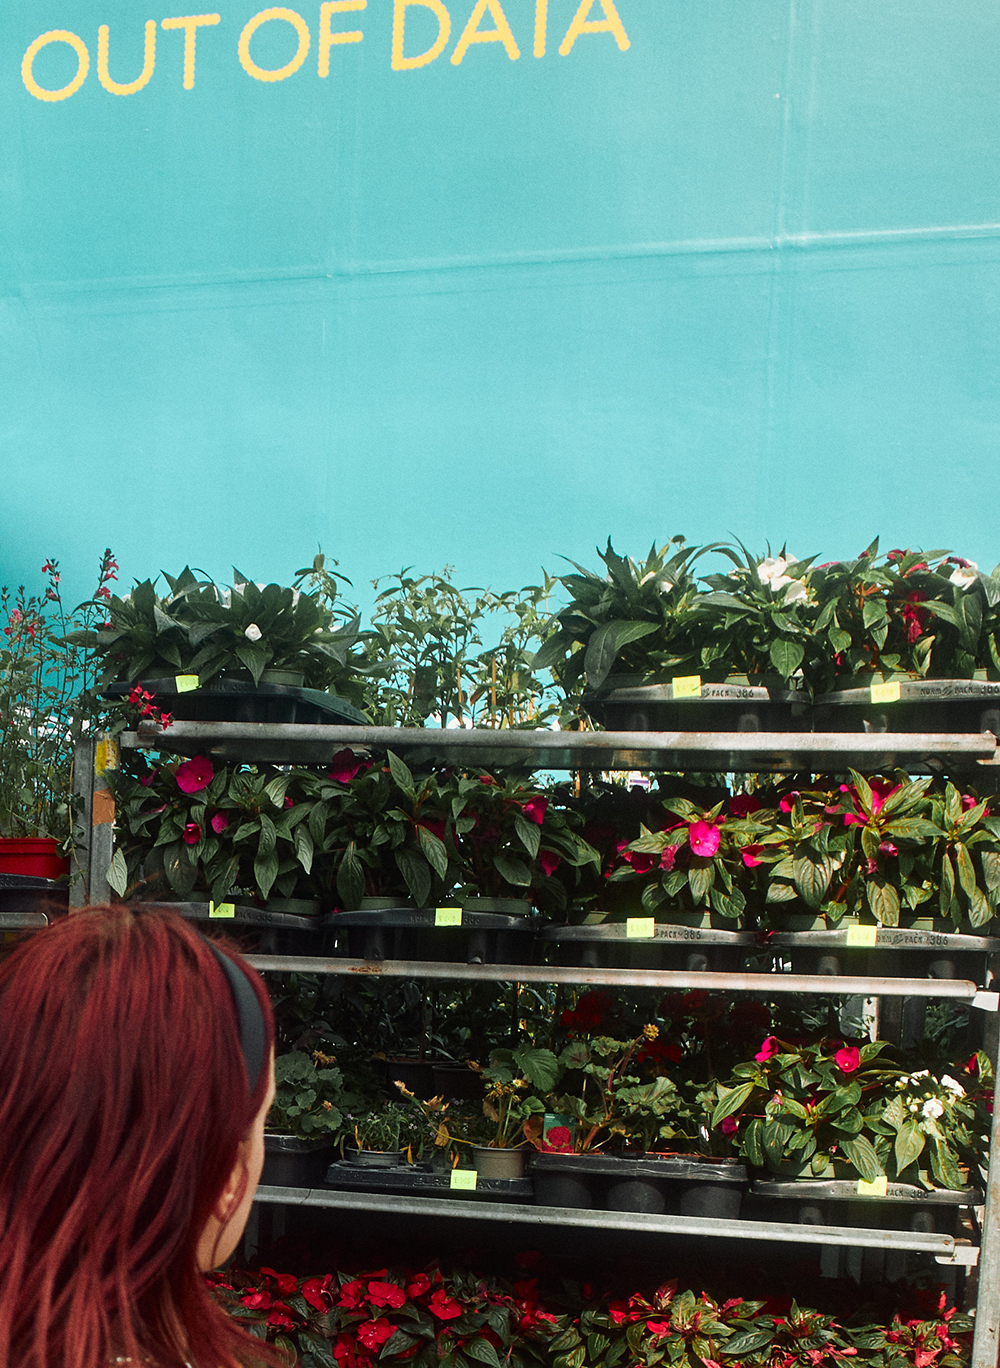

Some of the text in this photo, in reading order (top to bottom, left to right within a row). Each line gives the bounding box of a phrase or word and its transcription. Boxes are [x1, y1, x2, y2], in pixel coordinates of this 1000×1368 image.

[21, 13, 221, 102] OUT
[237, 0, 367, 83] OF
[711, 688, 754, 698] PACK 386
[954, 686, 973, 695] PACK
[660, 929, 701, 940] PACK 386
[876, 935, 949, 945] ORM PACK 386
